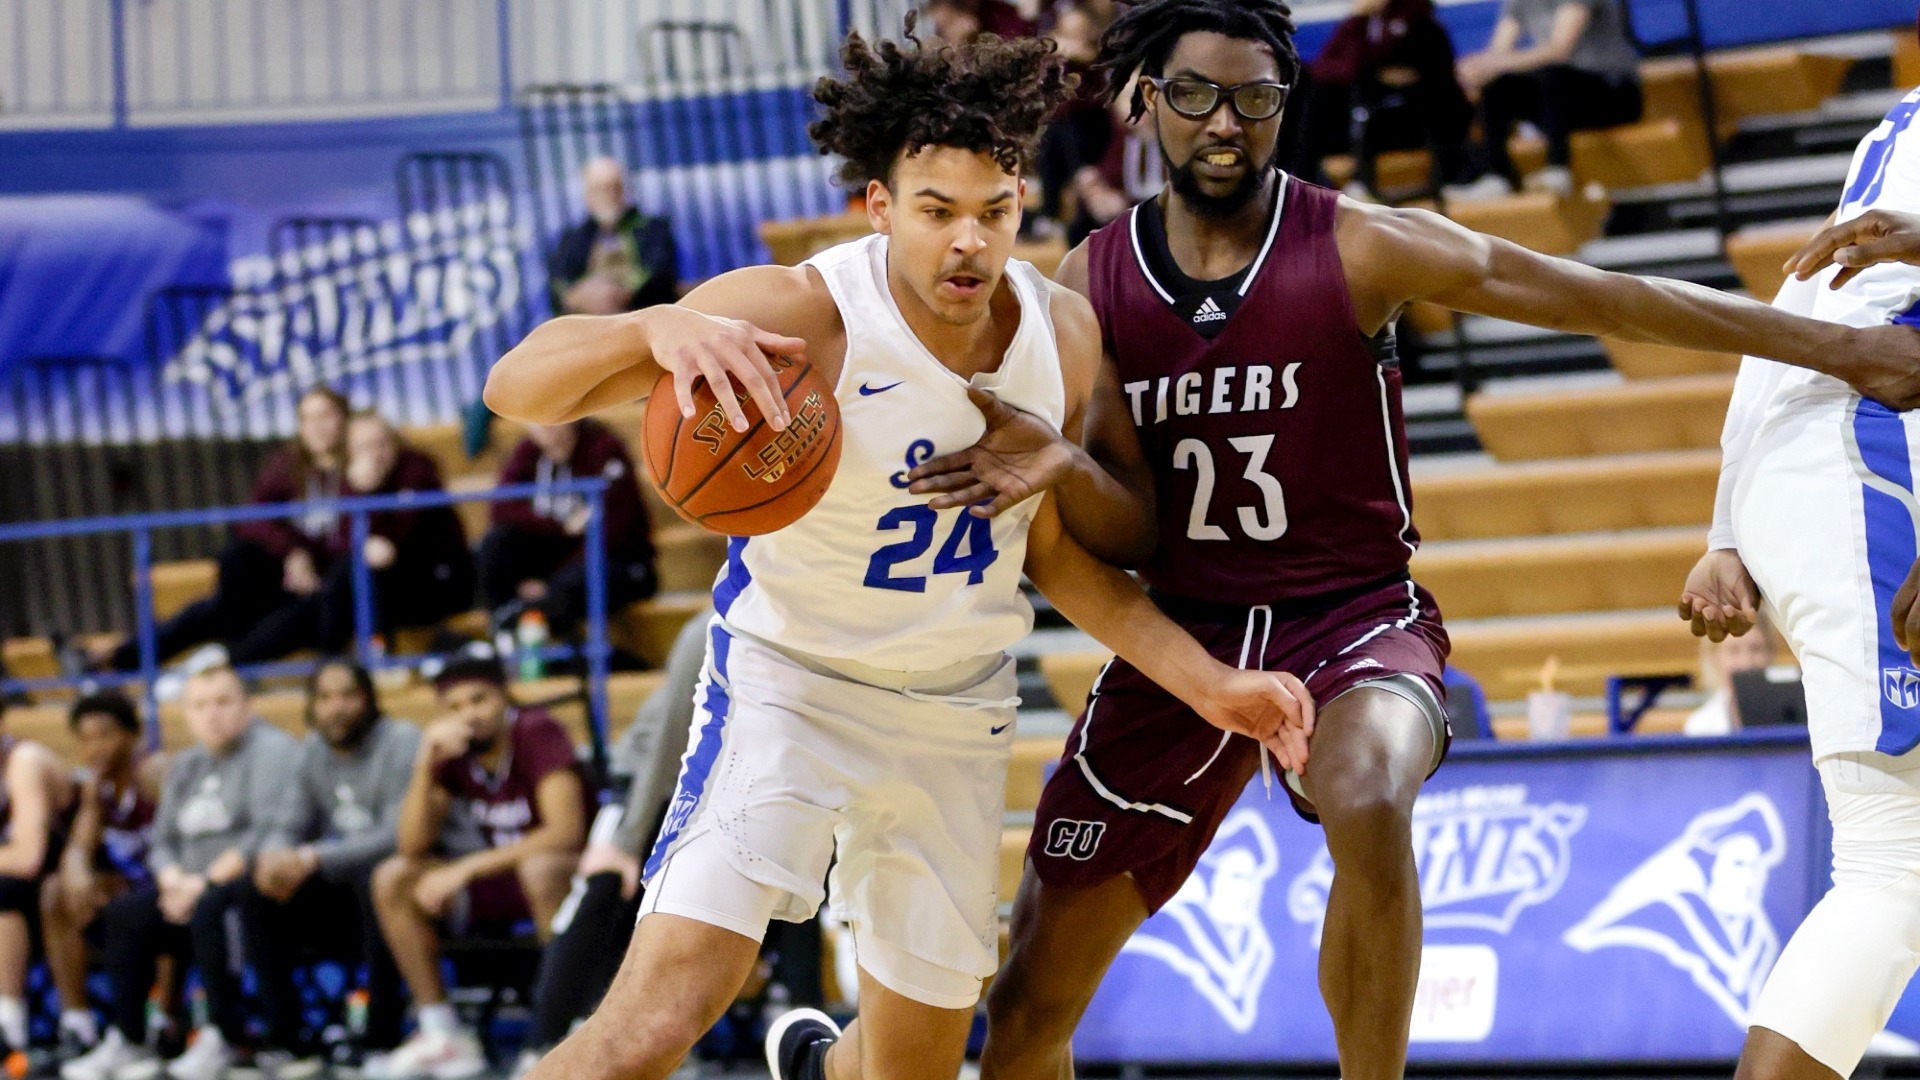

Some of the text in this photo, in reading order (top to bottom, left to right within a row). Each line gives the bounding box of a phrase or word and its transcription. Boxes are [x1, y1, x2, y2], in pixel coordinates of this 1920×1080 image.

[1193, 310, 1227, 323] adidas
[1124, 361, 1303, 427] TIGERS
[742, 388, 823, 480] LEGACY
[786, 411, 826, 467] 1000
[1172, 434, 1289, 542] 23
[863, 497, 999, 593] 24
[1044, 818, 1107, 860] CU
